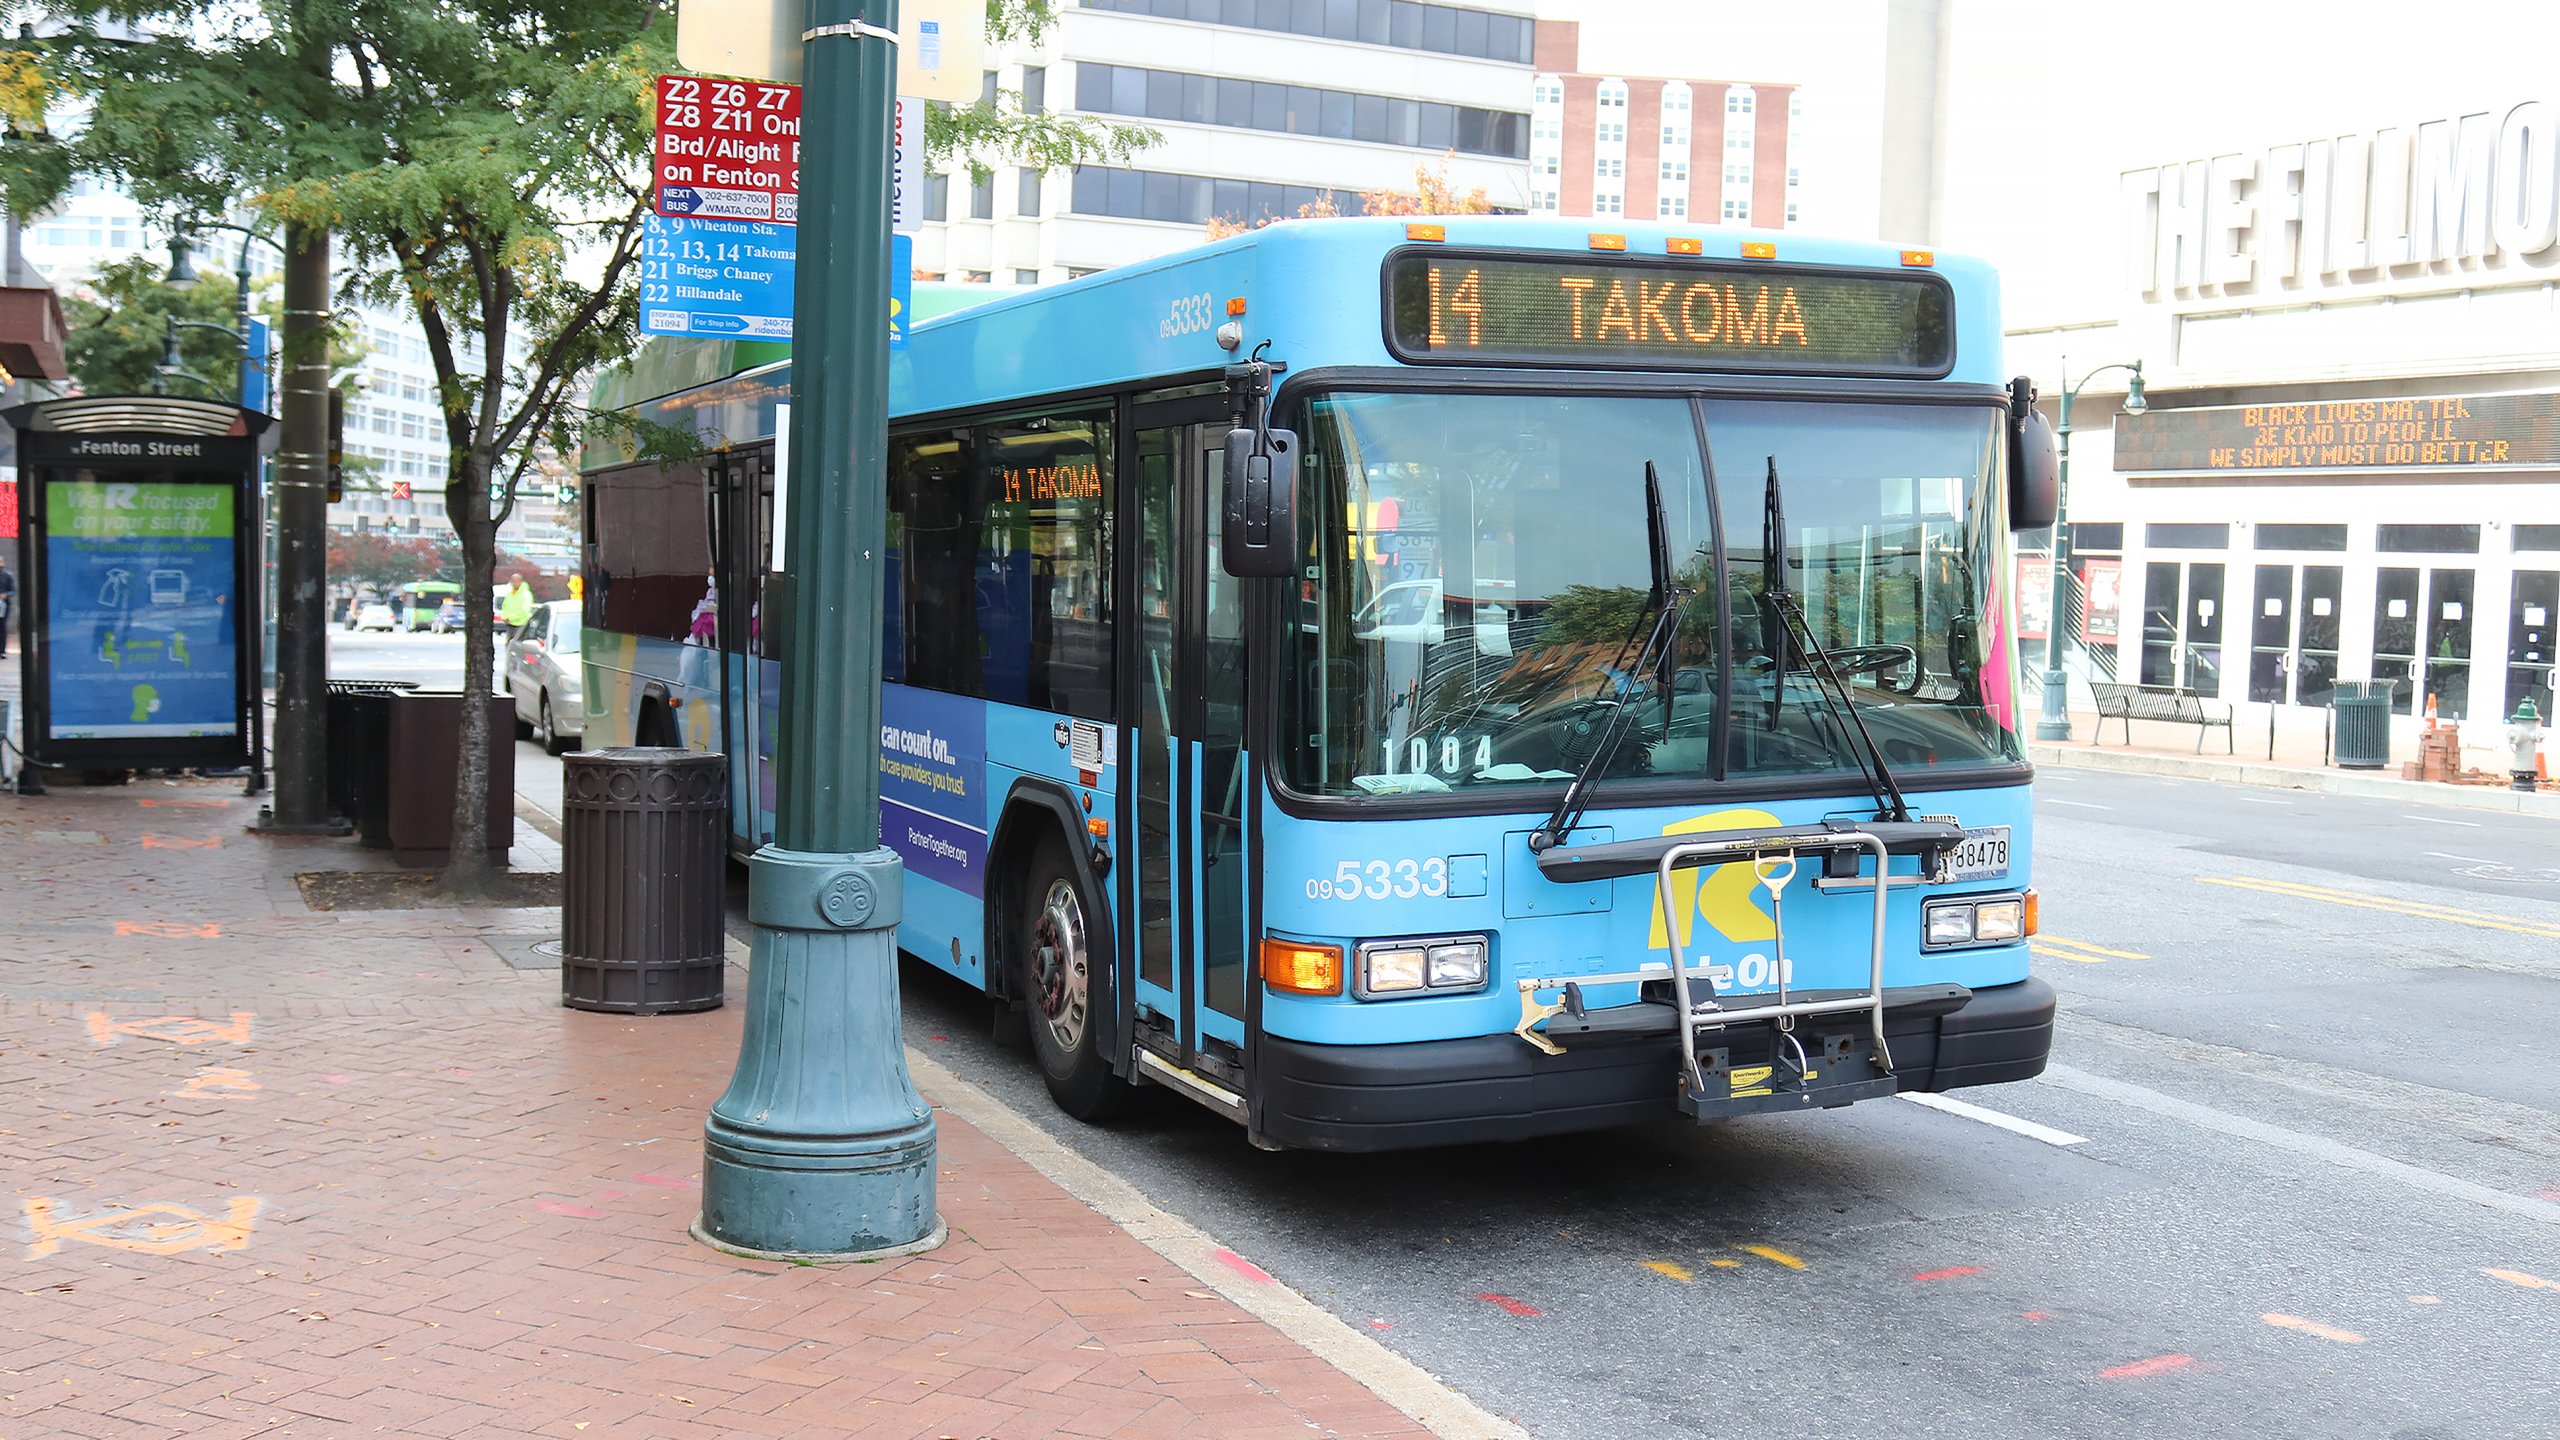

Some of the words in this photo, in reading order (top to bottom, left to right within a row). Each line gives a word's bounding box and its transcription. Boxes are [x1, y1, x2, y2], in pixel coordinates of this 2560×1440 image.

[664, 79, 700, 103] Z2
[711, 83, 747, 107] Z6
[757, 87, 791, 110] Z7
[664, 104, 700, 128] Z8
[712, 108, 752, 132] Z11
[763, 114, 800, 136] Onl
[663, 134, 781, 164] Brd/Alight
[663, 165, 692, 182] on
[702, 163, 781, 188] Fenton
[663, 188, 692, 199] NEXT
[705, 191, 769, 204] 202-637-7000
[2119, 153, 2260, 303] THE
[2265, 100, 2560, 292] FILLMO
[666, 201, 689, 212] BUS
[704, 204, 769, 217] WMATA.COM
[648, 215, 668, 237] 8,
[672, 217, 685, 235] 9
[689, 219, 748, 234] Wheaton
[751, 223, 777, 236] Sta.
[645, 238, 676, 261] 12,
[681, 240, 711, 264] 13,
[717, 242, 740, 262] 14
[743, 245, 797, 261] Takoma
[645, 261, 668, 280] 21
[676, 263, 719, 280] Briggs
[723, 266, 774, 284] Chaney
[644, 284, 669, 303] 22
[675, 286, 743, 302] Hillandale
[1428, 268, 1482, 346] 14
[1560, 277, 1808, 346] TAKOMA
[654, 319, 681, 329] 21094
[694, 319, 706, 327] For
[708, 319, 724, 329] Stop
[725, 321, 740, 329] Info
[755, 326, 792, 336] rideonbu
[2244, 406, 2308, 427] BLACK
[2314, 401, 2376, 425] LIVES
[2340, 423, 2368, 444] TO
[81, 440, 141, 455] Fenton
[148, 442, 201, 456] Street
[2210, 447, 2235, 467] WE
[2240, 446, 2316, 467] SIMPLY
[2321, 444, 2379, 466] MUST
[2386, 443, 2415, 465] DO
[1003, 469, 1021, 502] 14
[1027, 464, 1102, 499] TAKOMA
[142, 493, 220, 510] focused
[103, 516, 145, 533] your
[881, 725, 900, 751] can
[900, 730, 932, 759] count
[1383, 736, 1492, 776] 1004
[887, 757, 901, 777] care
[901, 763, 932, 787] providers
[932, 773, 946, 793] you
[946, 772, 966, 796] trust.
[908, 827, 967, 867] PartnerTogether.org
[1737, 953, 1793, 988] On
